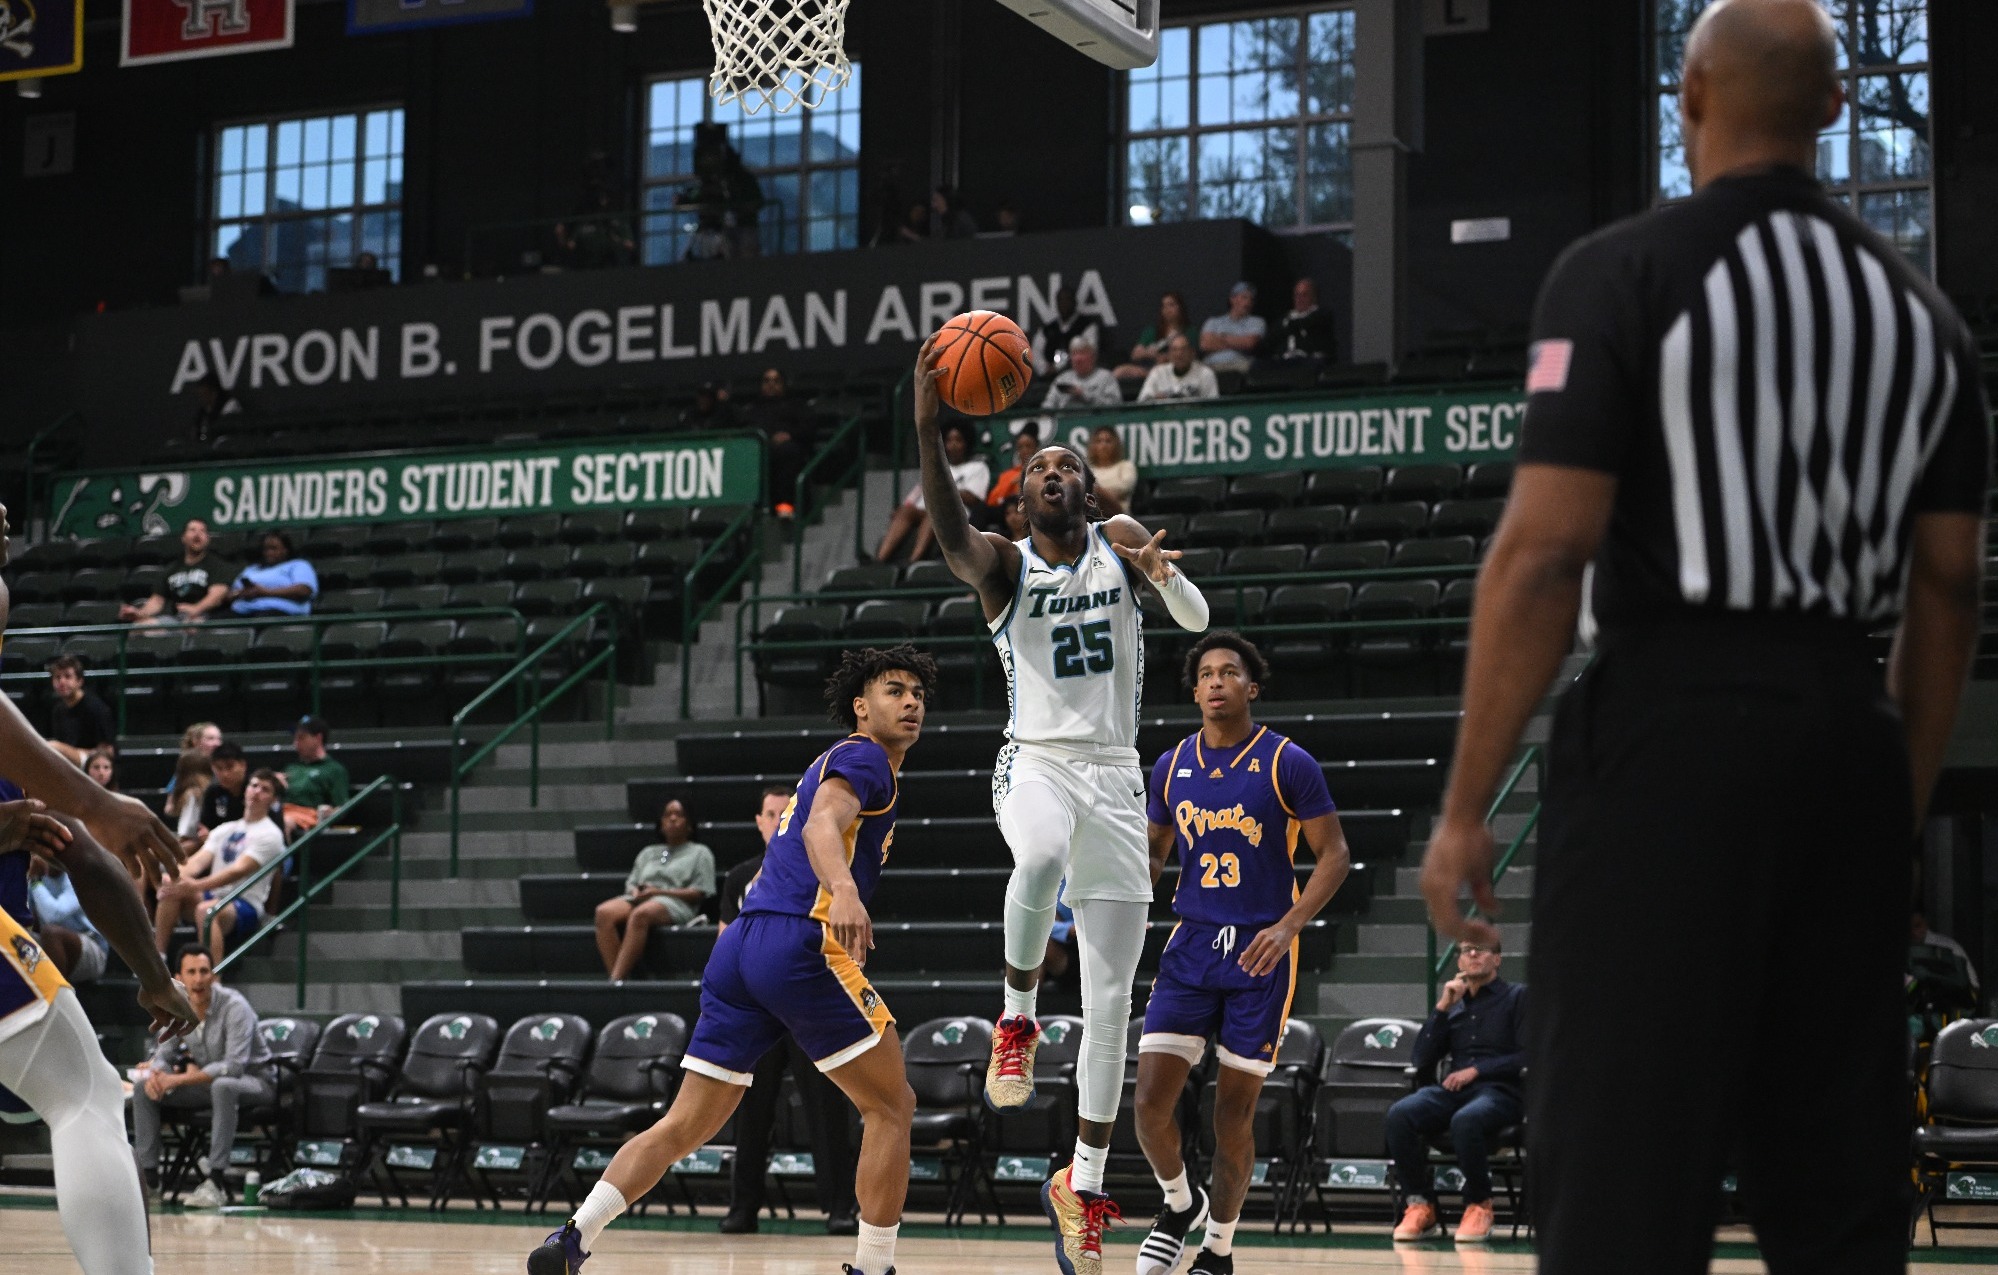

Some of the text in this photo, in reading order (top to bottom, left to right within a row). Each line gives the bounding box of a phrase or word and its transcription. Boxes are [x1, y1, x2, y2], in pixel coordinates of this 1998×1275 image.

[169, 269, 1118, 394] AVRON B. FOGELMAN ARENA
[1069, 415, 1251, 468] SUNDERS
[1264, 406, 1432, 461] STUDENT
[213, 447, 725, 525] SAUNDERS STUDENT SECTION
[1050, 618, 1115, 680] 25
[1247, 757, 1261, 773] A
[1176, 799, 1263, 851] Pirates
[1199, 852, 1241, 888] 23
